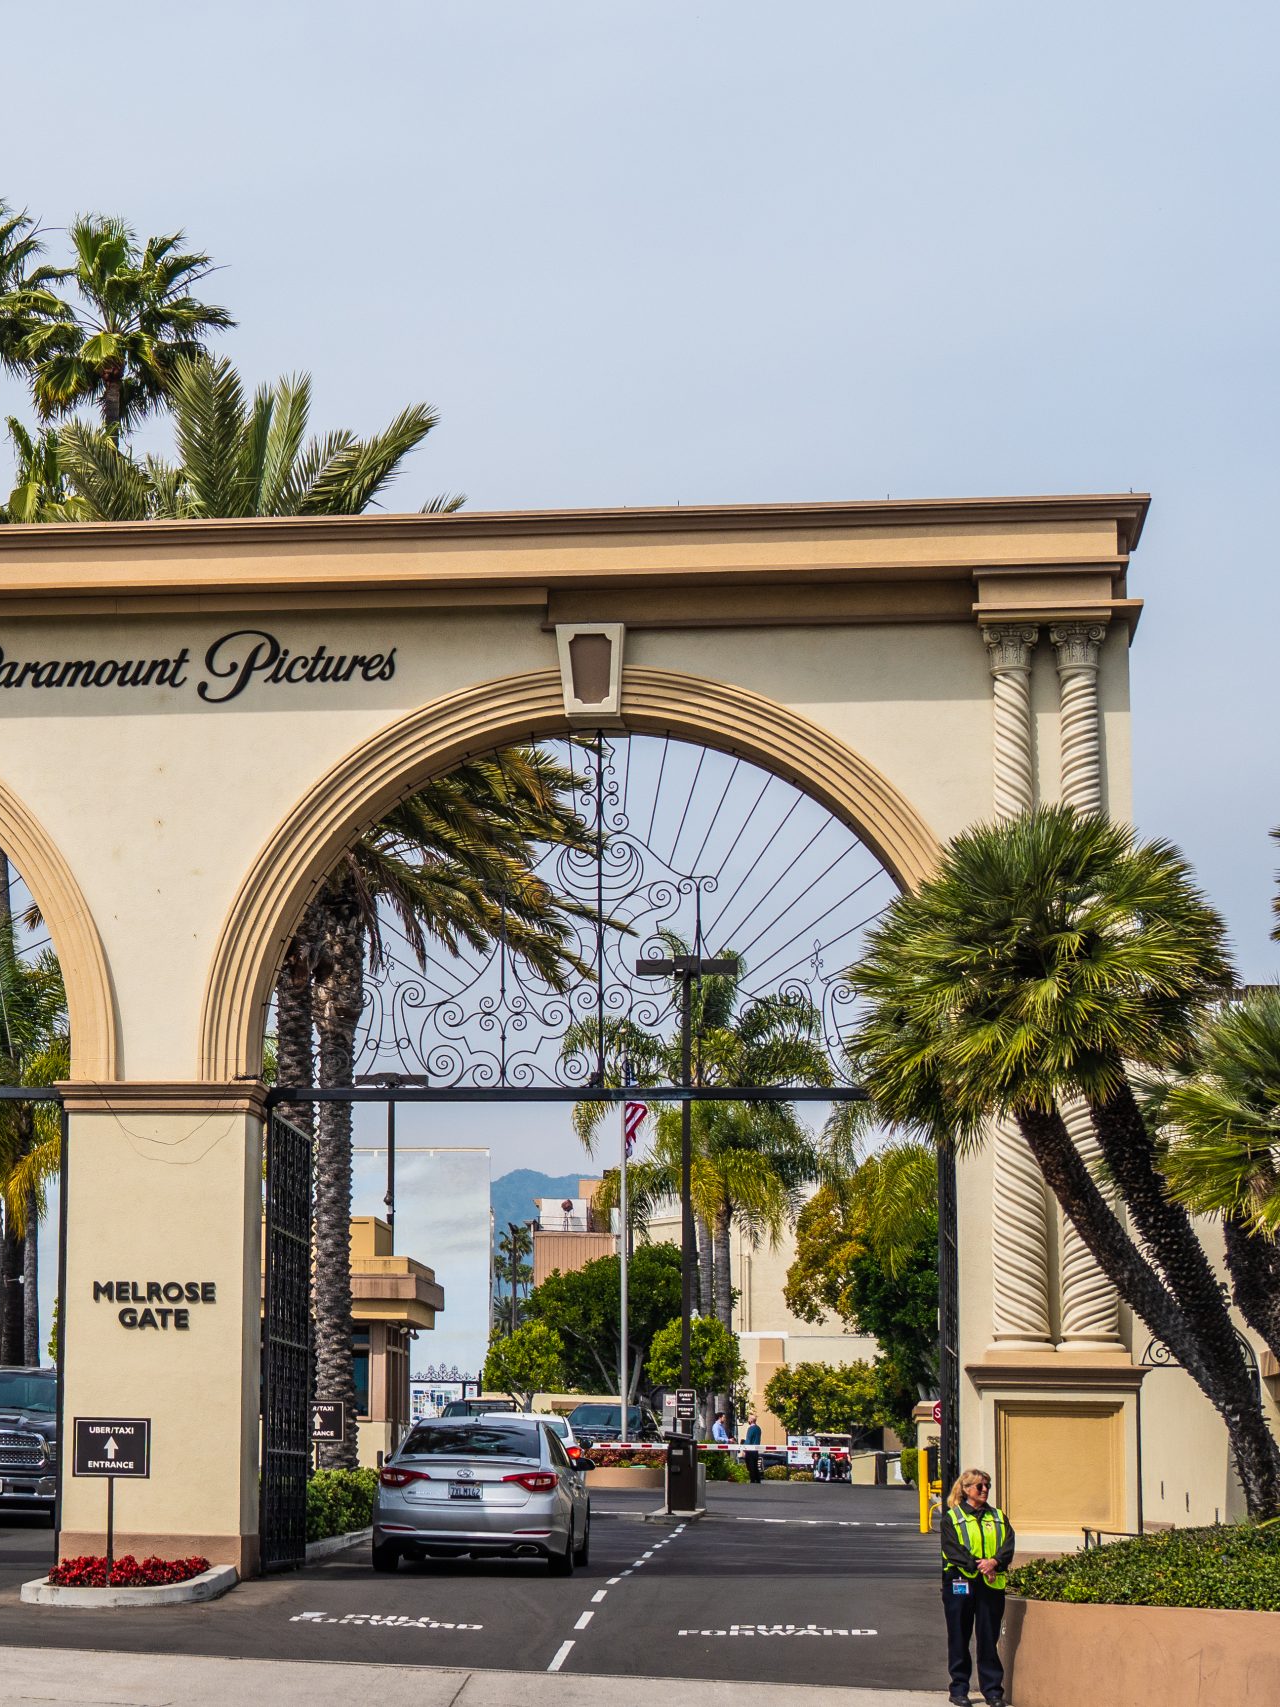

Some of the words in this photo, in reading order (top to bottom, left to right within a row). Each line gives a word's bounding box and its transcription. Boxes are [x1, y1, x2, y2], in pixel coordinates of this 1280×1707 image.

[197, 630, 397, 704] Pictures
[93, 1281, 216, 1303] MELROSE
[119, 1308, 190, 1328] GATE
[89, 1426, 134, 1434] UBER/TAXI
[87, 1461, 135, 1469] ENTRANCE
[289, 1616, 484, 1630] FORWARD
[344, 1613, 437, 1622] PULL
